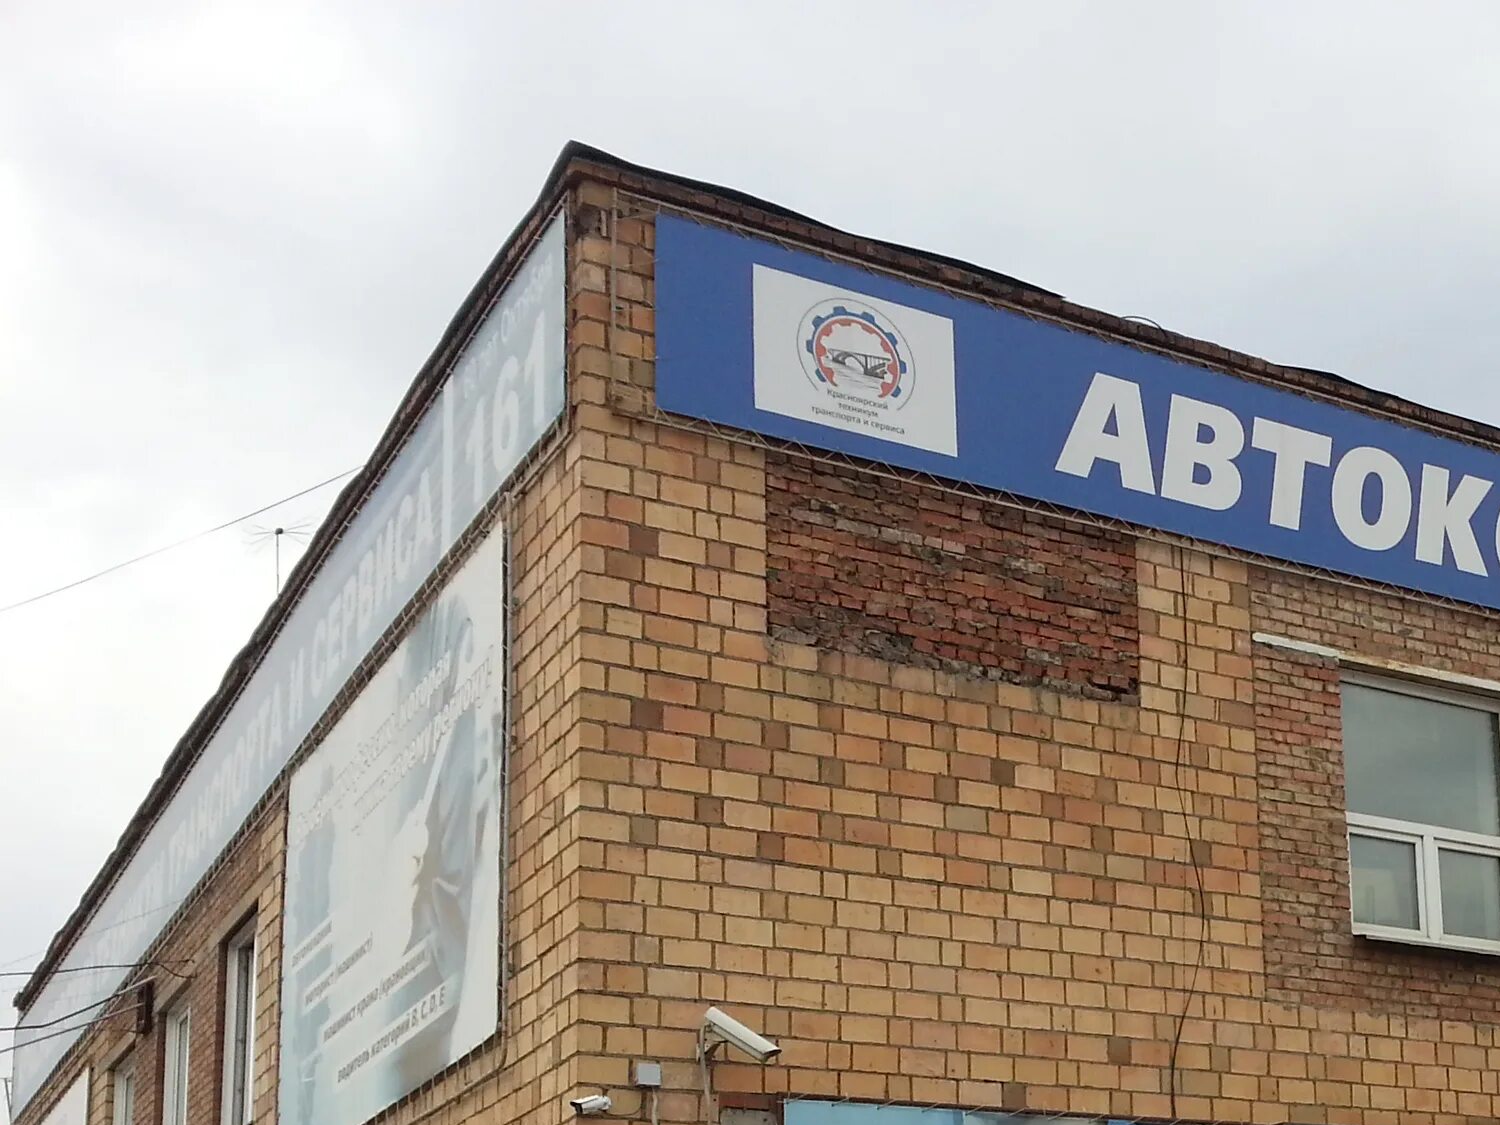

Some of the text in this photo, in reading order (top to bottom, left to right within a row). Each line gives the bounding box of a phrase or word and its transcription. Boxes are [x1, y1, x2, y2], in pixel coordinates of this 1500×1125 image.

[464, 309, 547, 508] 161
[827, 387, 889, 411] Красноярский
[838, 401, 879, 419] техникум
[811, 405, 905, 435] транспорта и сервиса
[309, 471, 436, 698] СЕРВИСА
